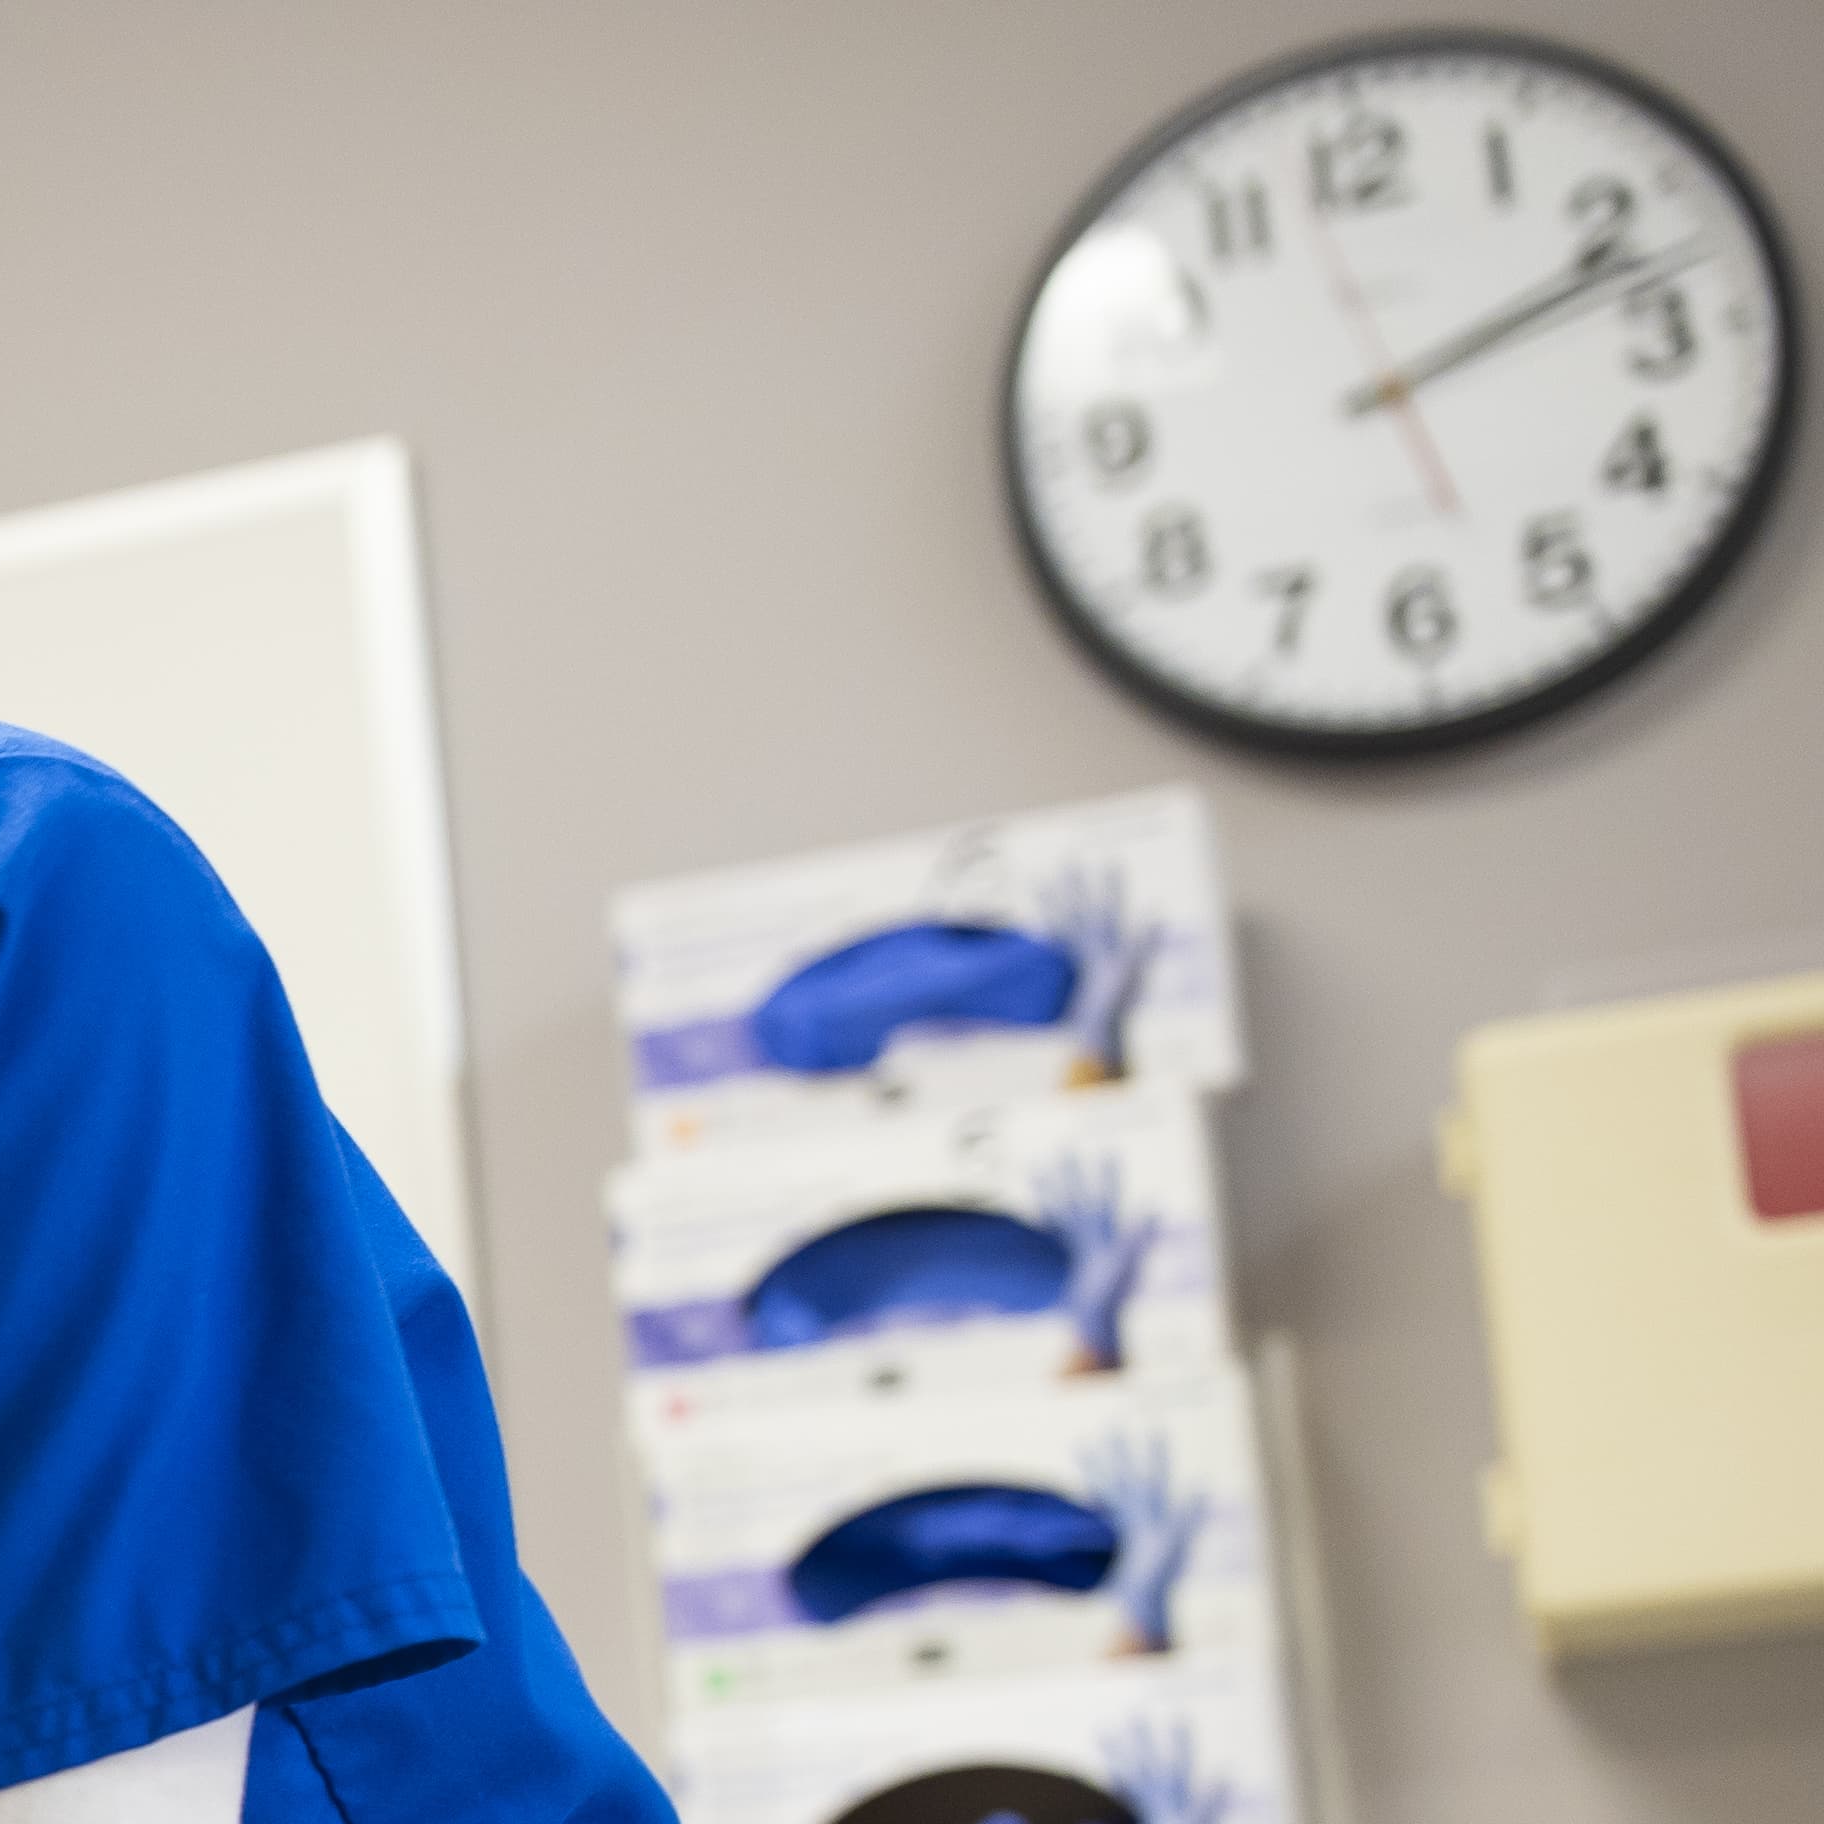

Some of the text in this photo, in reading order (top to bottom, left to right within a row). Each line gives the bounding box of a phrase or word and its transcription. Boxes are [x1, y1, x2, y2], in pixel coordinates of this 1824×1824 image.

[1306, 112, 1405, 208] 12
[1485, 122, 1516, 204] 1
[1201, 174, 1273, 259] 11
[1565, 174, 1636, 272] 2
[1622, 285, 1697, 380] 3
[1085, 402, 1149, 488] 9
[1602, 415, 1668, 492] 4
[1141, 511, 1207, 595] 8
[1524, 516, 1592, 602] 5
[1256, 565, 1315, 655] 7
[1386, 566, 1458, 658] 6
